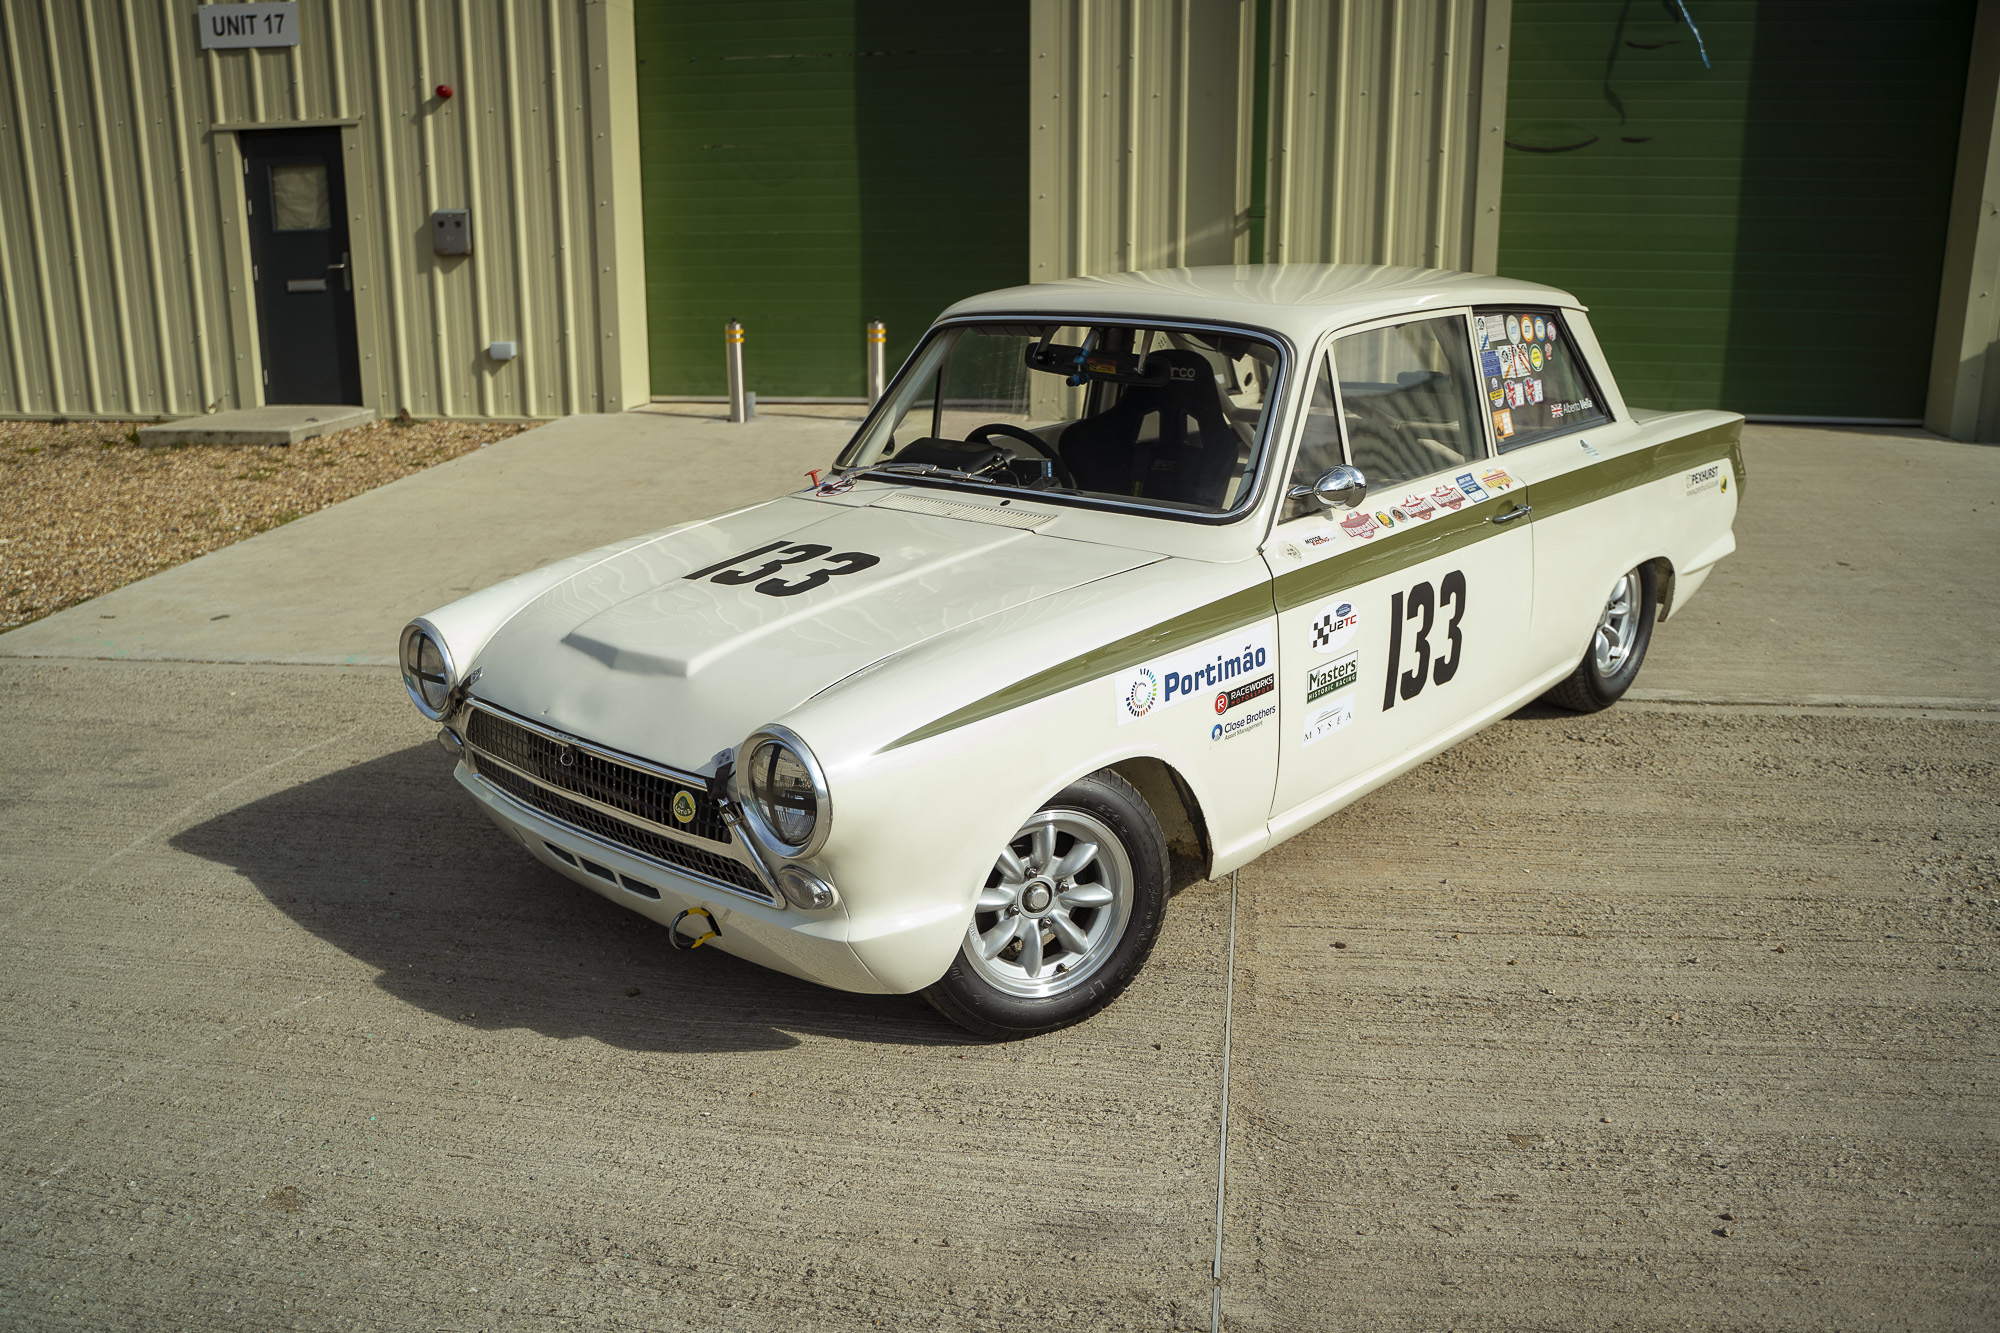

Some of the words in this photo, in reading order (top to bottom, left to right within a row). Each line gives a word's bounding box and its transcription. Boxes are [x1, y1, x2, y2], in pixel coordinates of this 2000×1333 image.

[212, 14, 257, 36] UNIT
[264, 13, 284, 34] 17
[1563, 402, 1580, 414] Alberto
[1579, 398, 1592, 409] Vella
[681, 540, 881, 597] 133
[1329, 614, 1357, 633] U2TC
[1382, 569, 1466, 712] 133
[1164, 644, 1266, 702] Portimão
[1309, 659, 1356, 691] Masters
[1230, 675, 1273, 700] RACEWORKS
[1230, 684, 1273, 706] MOTORSPORT
[1308, 683, 1334, 700] HISTORIC
[1335, 674, 1356, 688] RACING
[1217, 698, 1225, 710] R
[1224, 718, 1245, 733] Close
[1246, 705, 1276, 725] Brothers
[1224, 730, 1237, 740] Asset
[1236, 720, 1263, 734] Management
